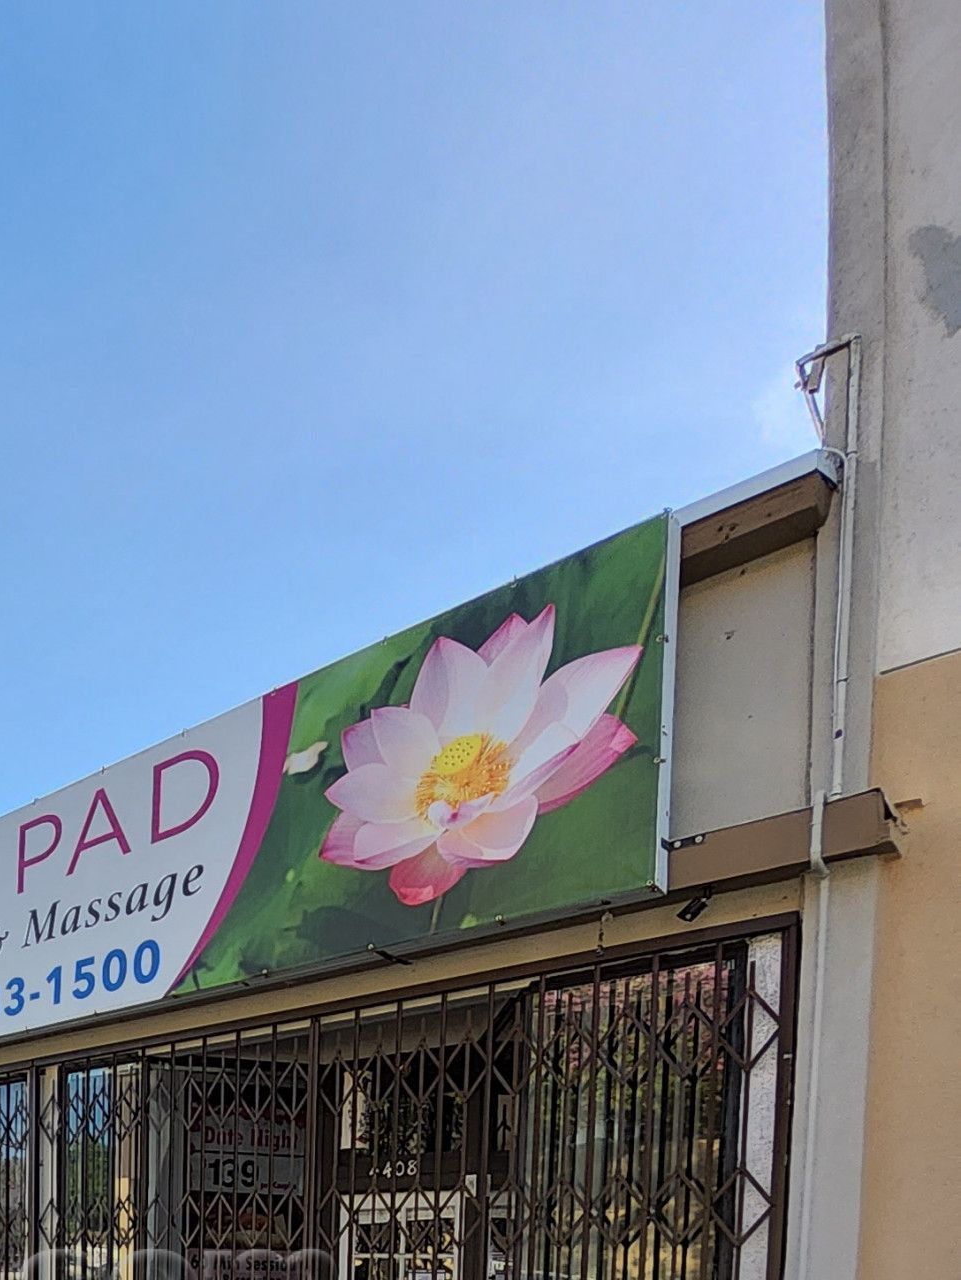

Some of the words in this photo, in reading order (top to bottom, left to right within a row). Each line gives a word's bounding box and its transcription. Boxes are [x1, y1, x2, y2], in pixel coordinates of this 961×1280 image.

[16, 749, 220, 895] PAD
[21, 864, 205, 949] Massage
[203, 1157, 260, 1188] 139
